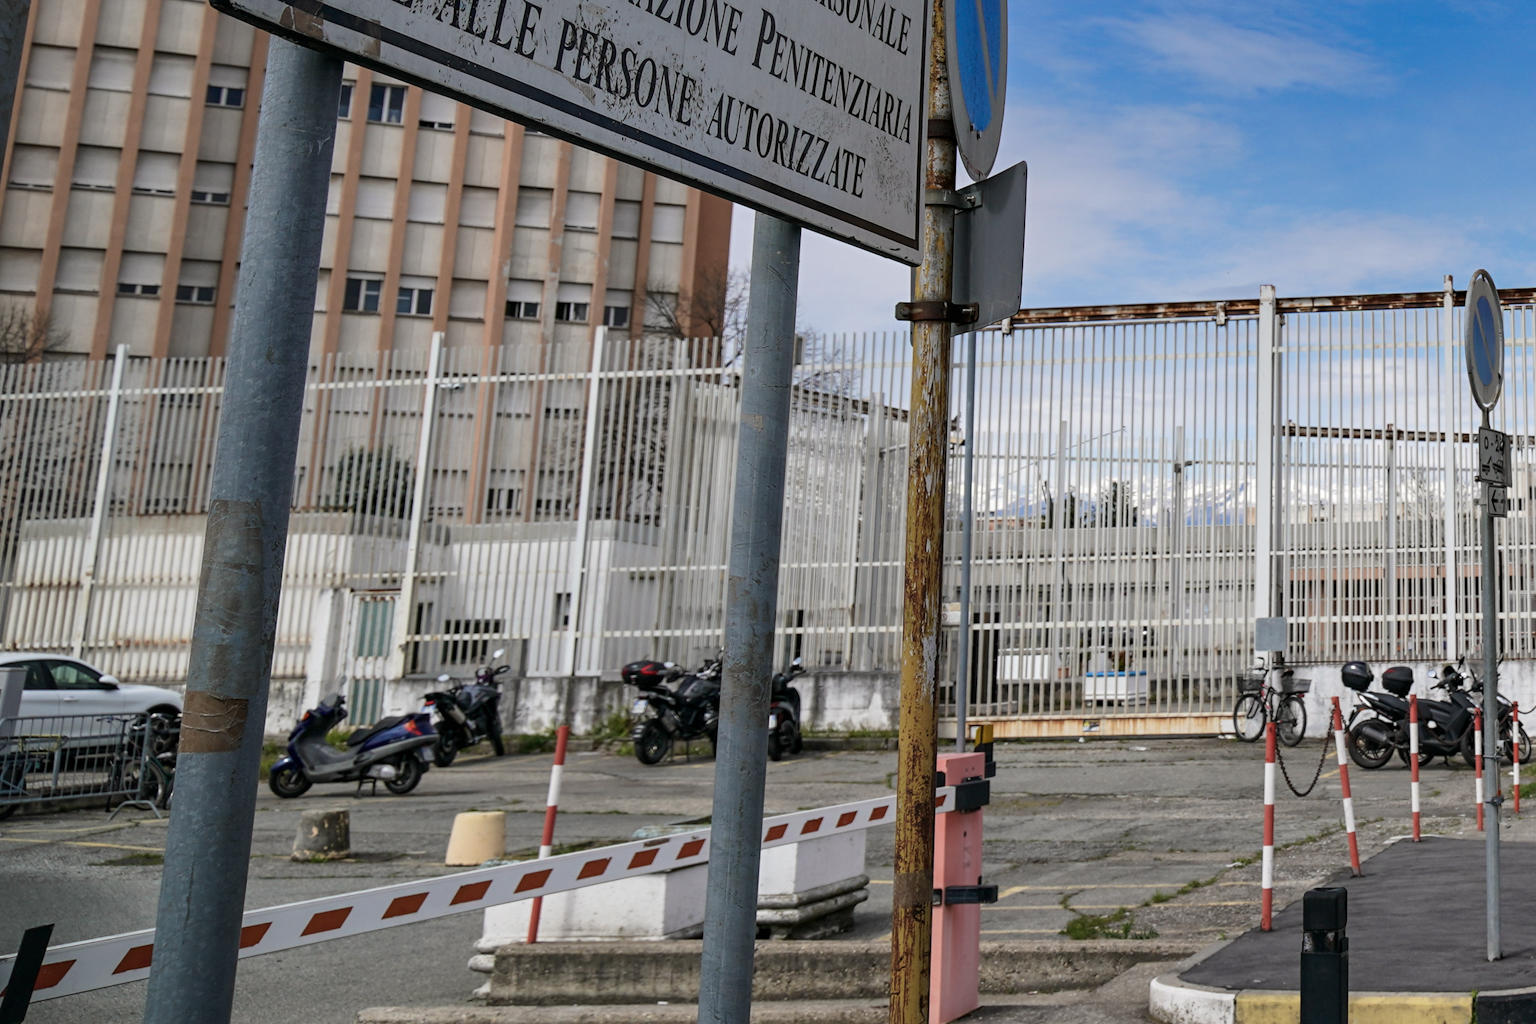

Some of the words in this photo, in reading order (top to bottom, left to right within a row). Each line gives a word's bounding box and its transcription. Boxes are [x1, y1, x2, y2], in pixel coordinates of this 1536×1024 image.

[553, 17, 698, 127] PERSONE
[706, 92, 867, 199] AUTORIZZATE
[752, 8, 913, 145] PENITENZIARIA
